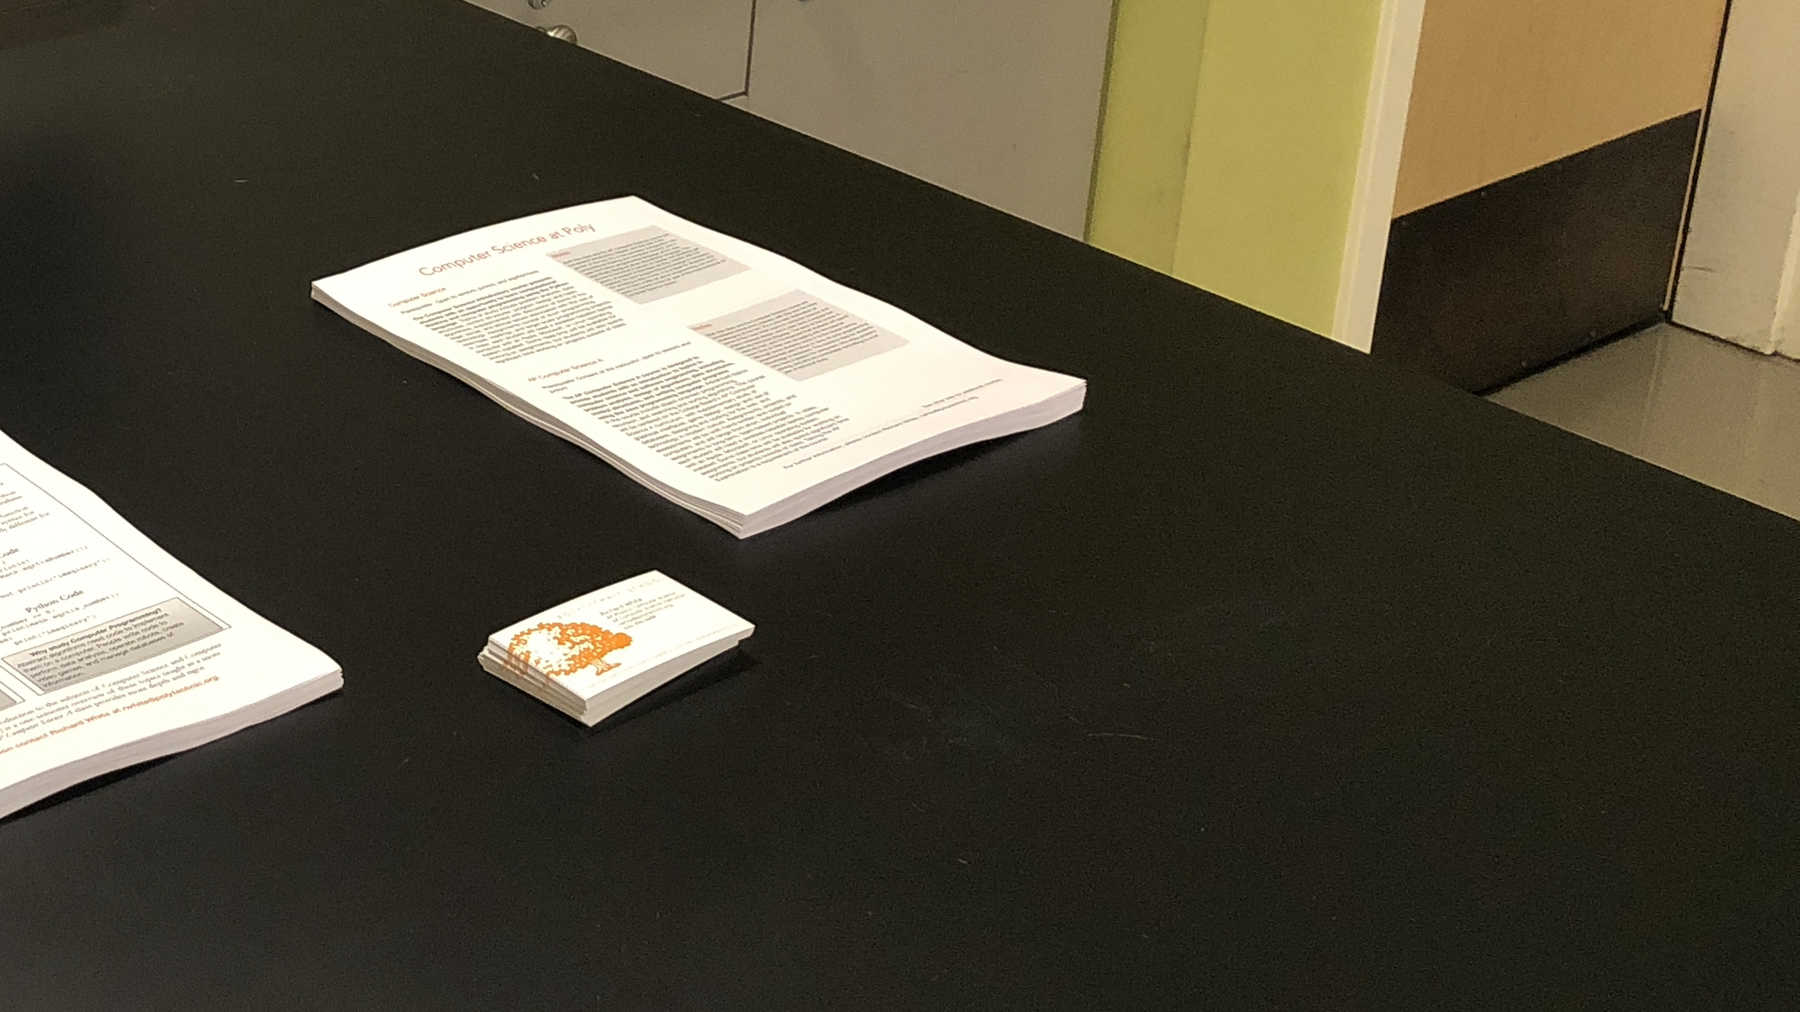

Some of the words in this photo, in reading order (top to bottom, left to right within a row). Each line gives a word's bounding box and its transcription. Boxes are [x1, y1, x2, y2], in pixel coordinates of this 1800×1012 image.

[418, 247, 492, 277] Computer
[491, 232, 548, 256] Science
[548, 228, 563, 241] at
[562, 221, 596, 238] Poly
